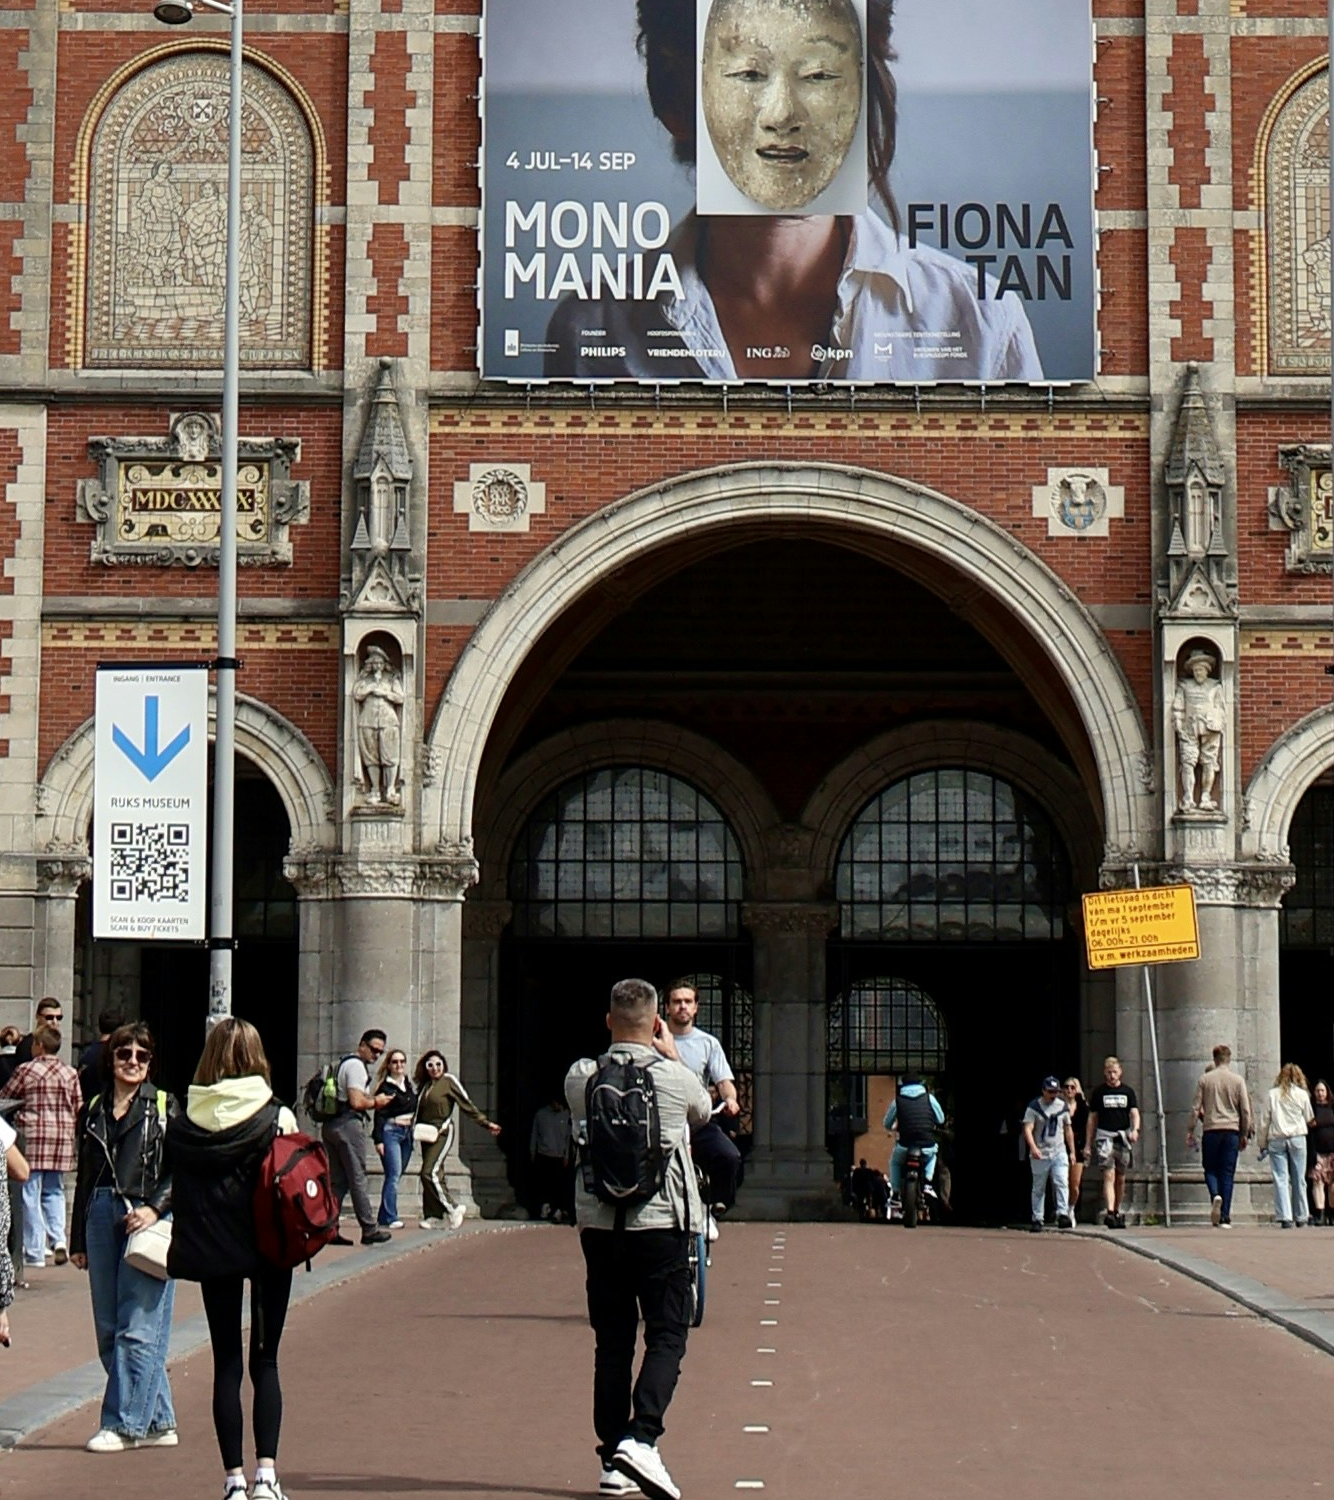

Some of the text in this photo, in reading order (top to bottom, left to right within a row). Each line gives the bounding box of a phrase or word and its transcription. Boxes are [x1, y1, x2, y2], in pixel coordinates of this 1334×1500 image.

[506, 151, 520, 169] 4
[599, 151, 636, 170] SEP
[505, 200, 670, 249] MONO
[908, 203, 1074, 250] FIONA
[504, 252, 686, 300] MANIA
[965, 254, 1072, 300] TAN
[580, 346, 627, 357] PHILIPS
[746, 347, 772, 358] ING
[827, 346, 854, 361] kpn
[145, 675, 181, 683] ENTRANCE
[142, 797, 191, 809] MUSEUM
[1153, 890, 1175, 900] dicht
[1088, 907, 1105, 916] van
[1107, 906, 1120, 914] ma
[1128, 902, 1175, 914] september
[110, 915, 128, 923] SCAN
[137, 916, 156, 924] KOOP
[157, 917, 189, 925] KAARTEN
[1089, 918, 1107, 927] t/m
[1111, 917, 1119, 925] vr
[1129, 912, 1175, 924] september
[110, 924, 128, 932] SCAN
[152, 925, 180, 933] TICKETS
[1090, 926, 1131, 939] dagelijks
[1094, 945, 1194, 962] i.v.m. werkzaamheden
